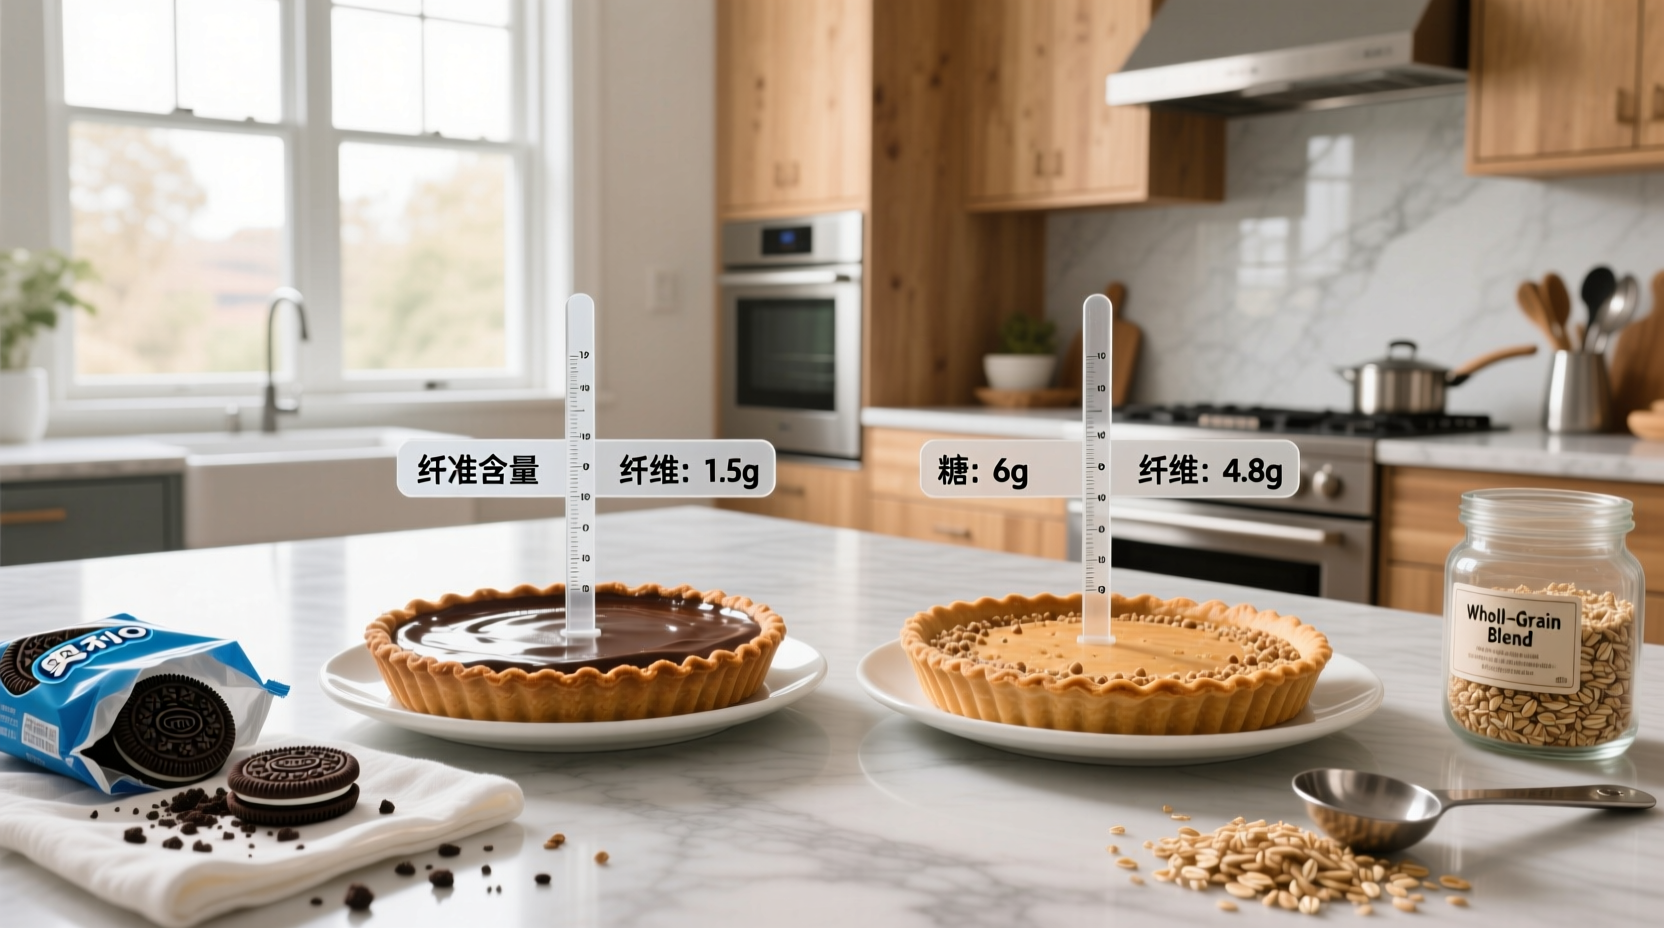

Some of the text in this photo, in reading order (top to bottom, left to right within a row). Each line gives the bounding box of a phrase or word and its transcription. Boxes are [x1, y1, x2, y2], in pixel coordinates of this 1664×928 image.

[417, 454, 539, 485] 纤准含量
[704, 458, 759, 489] 1.5g
[993, 457, 1028, 490] 6g
[1222, 457, 1283, 490] 4.8g
[1467, 604, 1561, 630] Wholl-Grain
[1488, 626, 1533, 647] Blend
